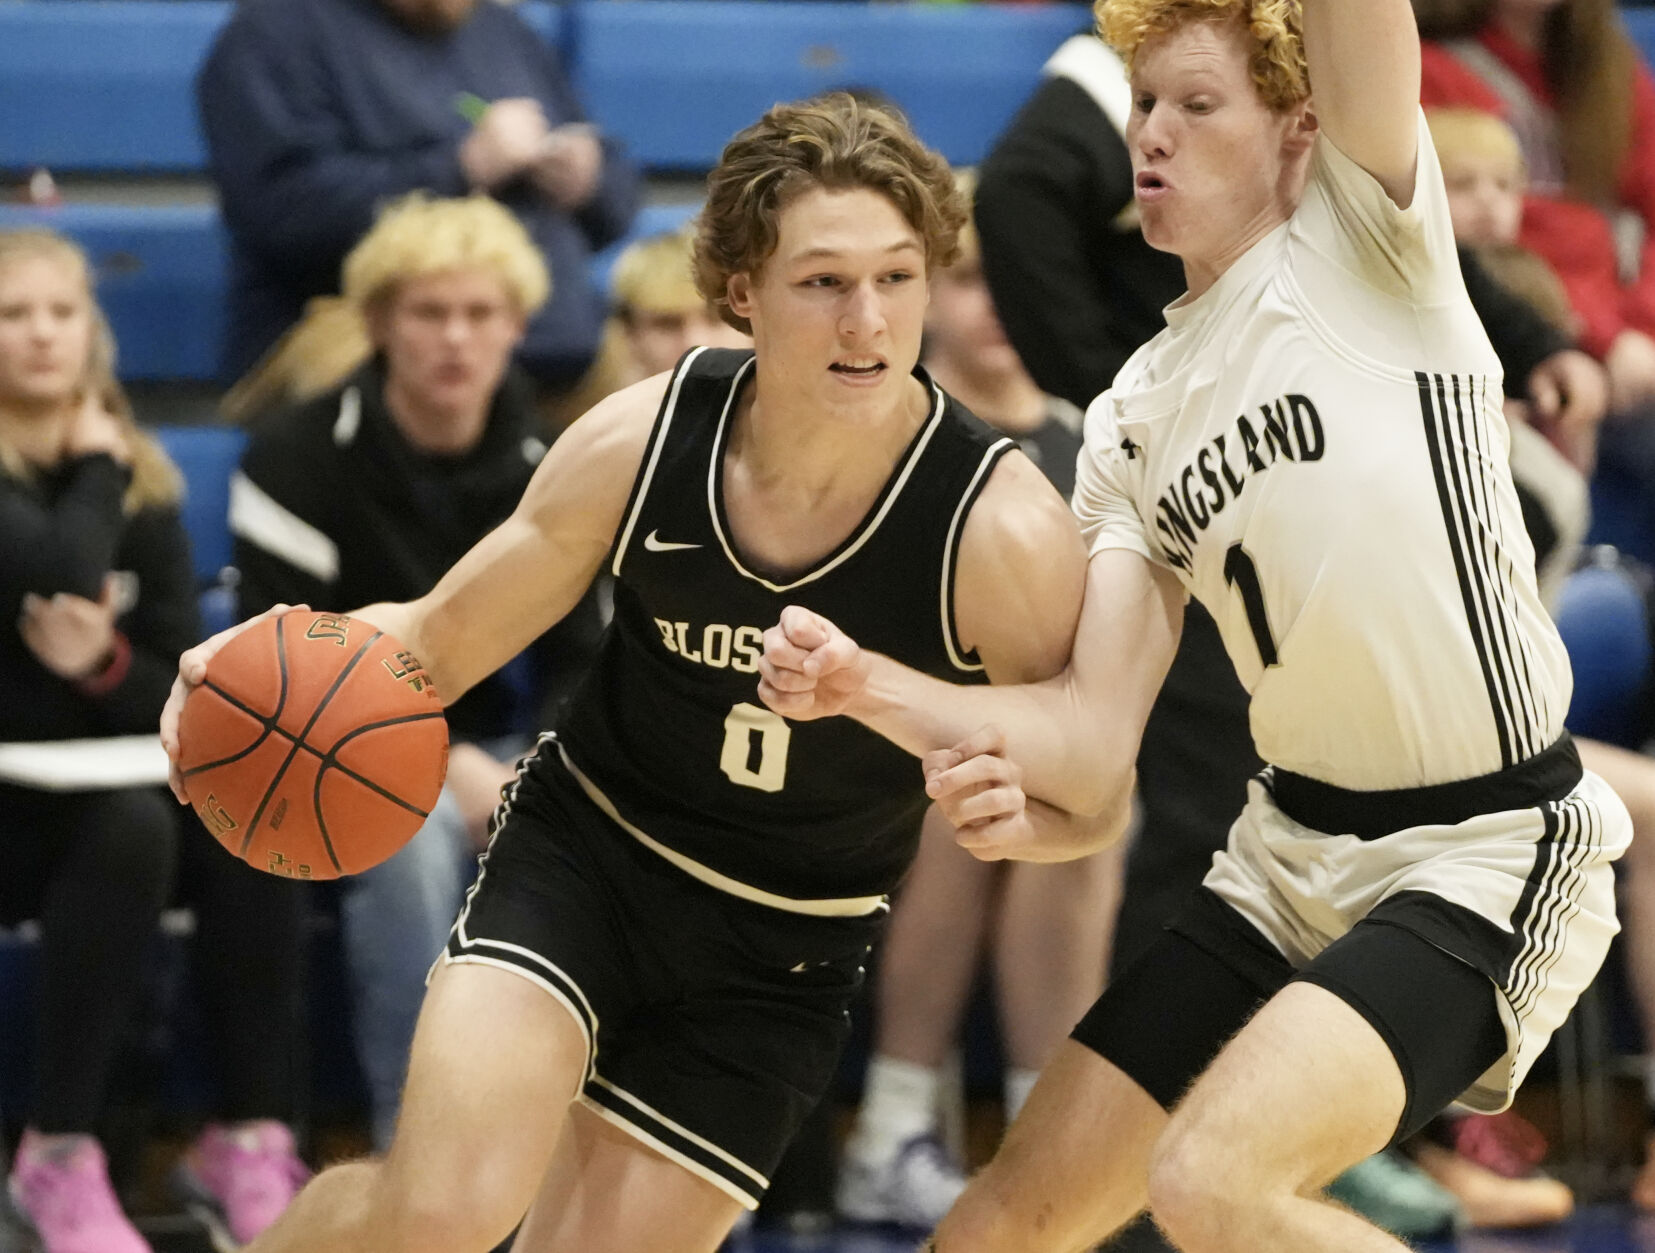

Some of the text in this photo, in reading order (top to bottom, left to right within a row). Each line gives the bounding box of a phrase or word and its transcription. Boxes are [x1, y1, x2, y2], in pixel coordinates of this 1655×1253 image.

[654, 617, 763, 674] BLOS
[1223, 542, 1279, 669] 1
[720, 702, 791, 792] 0
